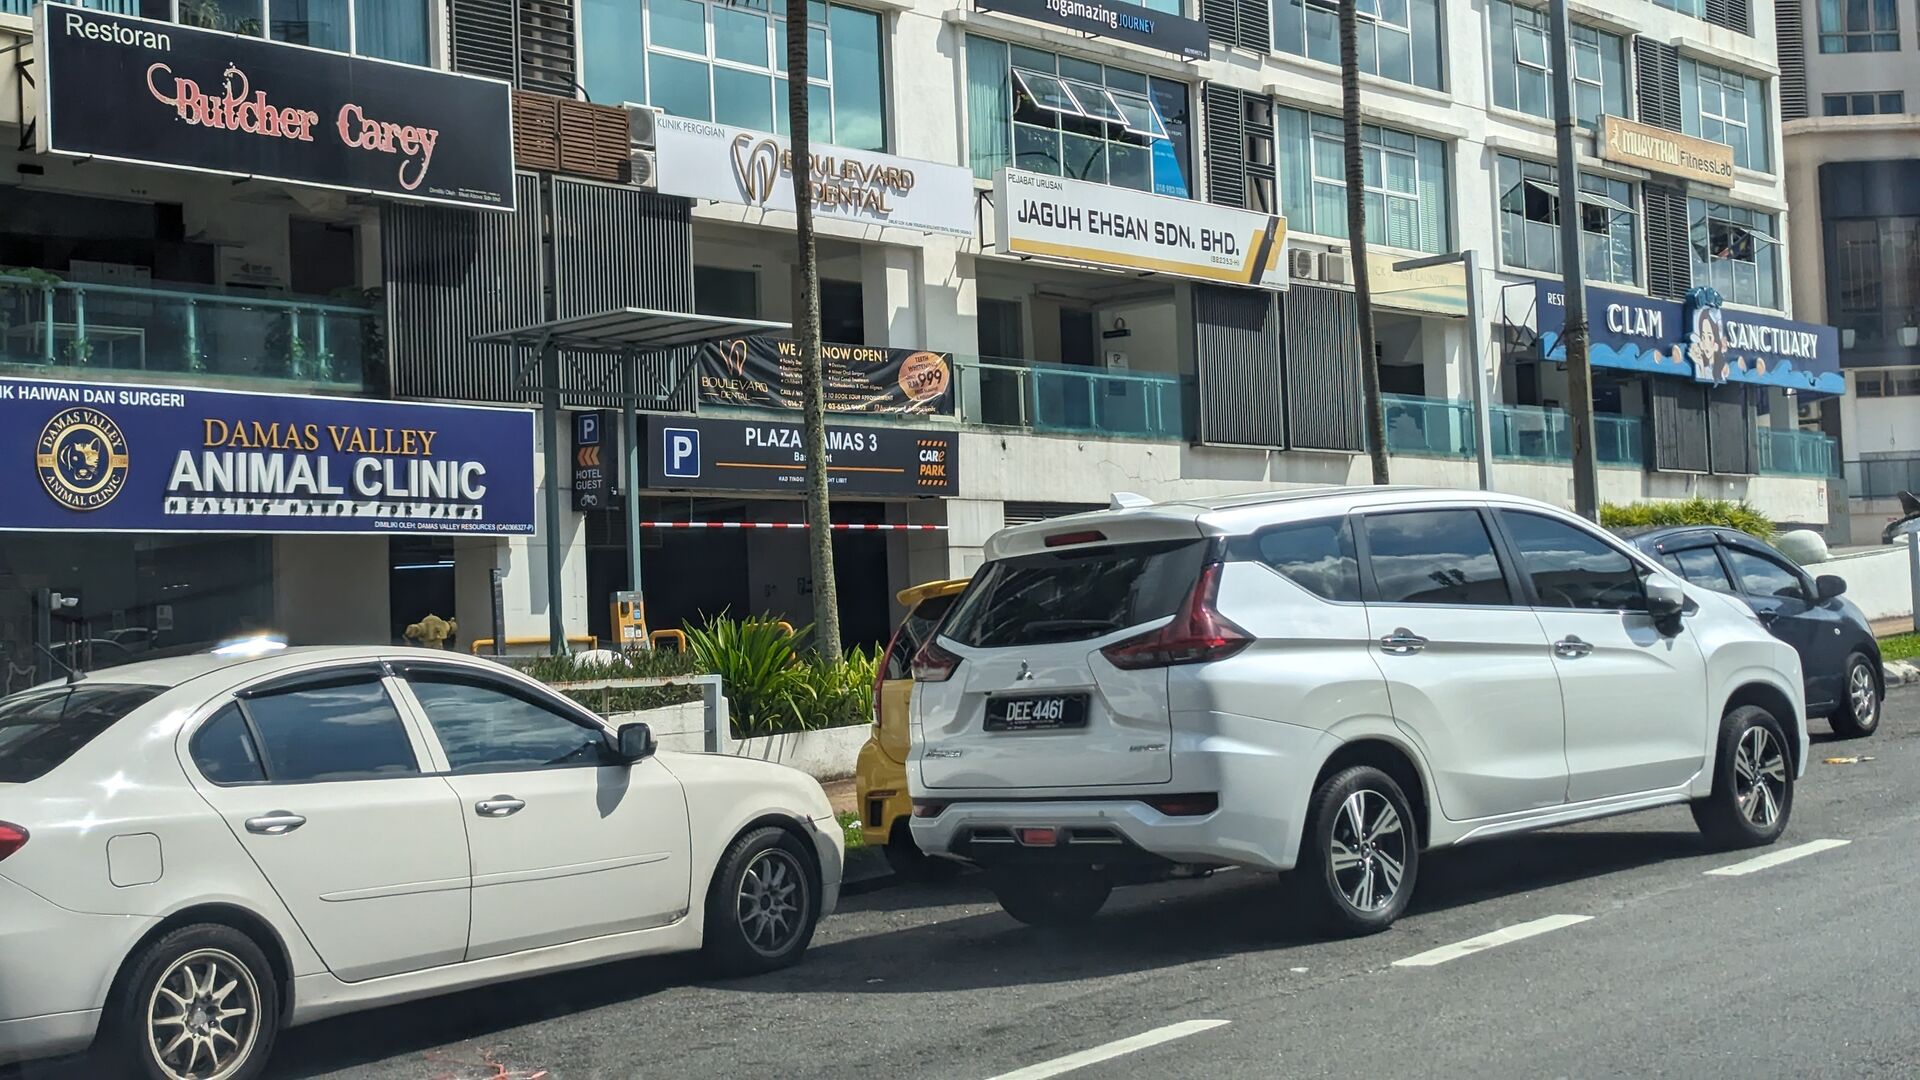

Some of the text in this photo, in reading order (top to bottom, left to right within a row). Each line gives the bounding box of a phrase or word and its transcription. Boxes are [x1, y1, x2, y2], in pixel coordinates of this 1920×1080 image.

[65, 13, 171, 51] Restoran
[1119, 14, 1155, 34] JOURNEY
[147, 61, 439, 190] Butcher Carey
[657, 117, 725, 138] KLINIK PERGIGIAN
[1622, 129, 1732, 177] MUAYTHAI FitnessLab
[1008, 173, 1063, 191] PEJABAT URUSAN
[808, 181, 894, 213] DENTAL
[1018, 199, 1240, 256] JAGUH EHSAN SDN. BHD.
[1547, 292, 1564, 306] REST
[1606, 303, 1818, 359] CLAM SANCTUARY
[778, 343, 796, 356] WE
[821, 347, 850, 360] NOW
[853, 348, 882, 362] OPEN
[701, 376, 769, 393] BOULEVARD
[917, 368, 943, 388] 999
[18, 386, 80, 402] HAIWAN
[83, 389, 115, 404] DAN
[119, 391, 185, 407] SURGERI
[720, 390, 751, 401] DENTAL
[43, 411, 123, 448] DAMAS VALLEY
[203, 418, 437, 455] DAMAS VALLEY
[583, 419, 595, 440] P
[745, 427, 877, 452] PLAZA MAS 3
[673, 435, 693, 470] P
[794, 451, 833, 463] Bant
[166, 450, 488, 500] ANIMAL CLINIC
[575, 469, 602, 479] HOTEL
[575, 479, 602, 490] GUEST
[46, 474, 121, 506] ANIMAL CLINIC
[169, 499, 480, 519] HEALING HANDS FOR PAWS
[417, 522, 438, 530] DAMAS
[1006, 699, 1064, 722] DEE 4461
